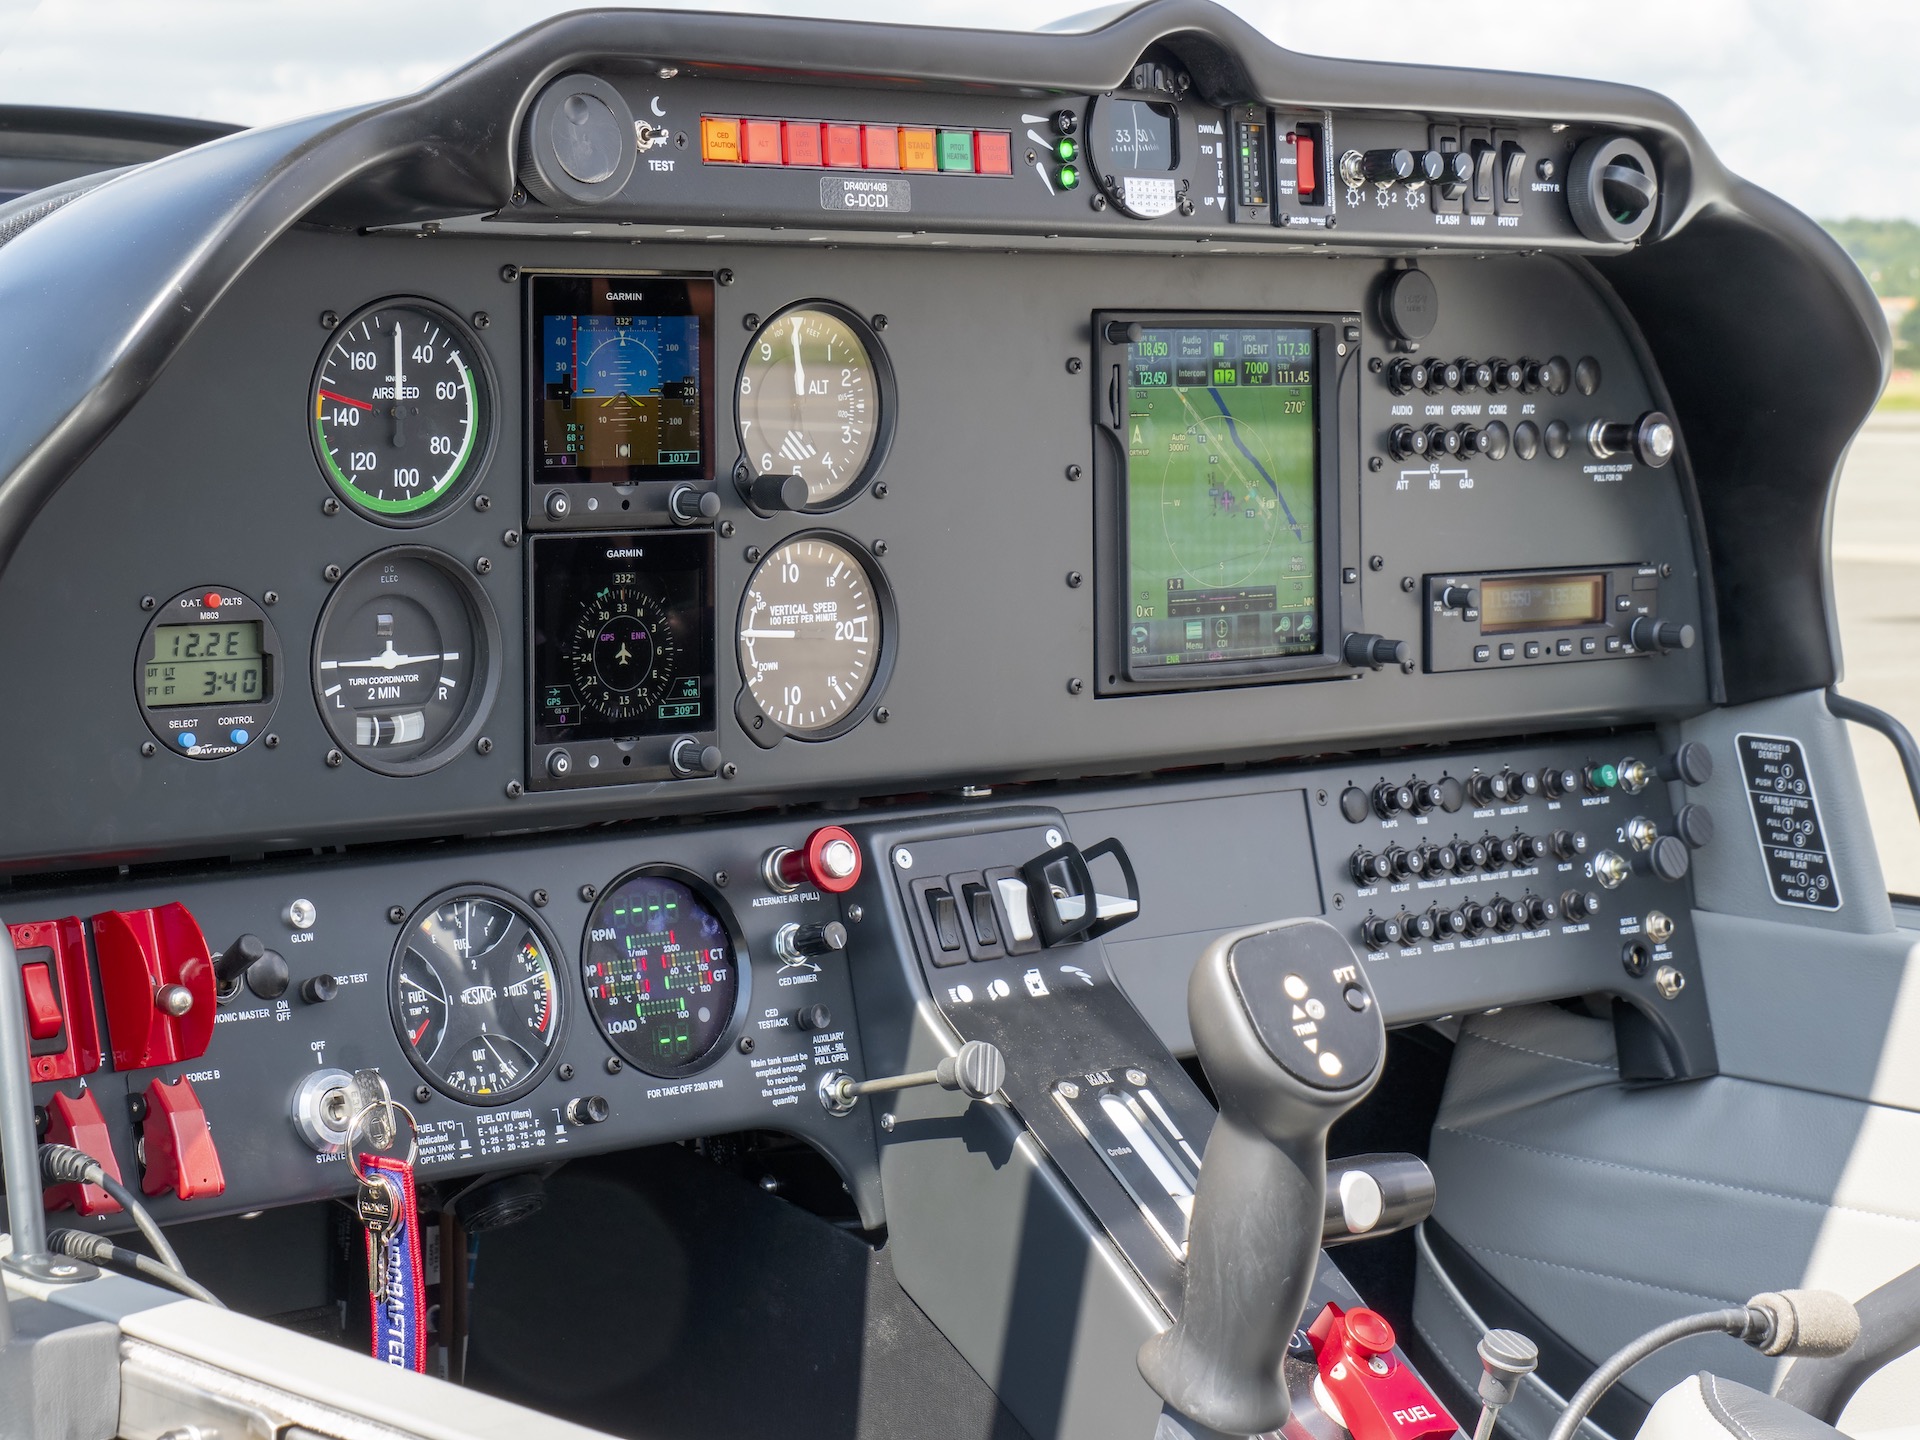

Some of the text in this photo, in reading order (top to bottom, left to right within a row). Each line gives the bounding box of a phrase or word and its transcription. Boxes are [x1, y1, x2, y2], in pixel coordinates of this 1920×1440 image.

[1199, 125, 1214, 134] DWN
[1116, 130, 1130, 143] 33
[648, 160, 675, 172] TEST
[844, 181, 888, 192] DR400/140B
[844, 193, 888, 208] G-DCDI
[1435, 215, 1459, 225] FLASH
[1471, 216, 1485, 226] NAV
[1498, 217, 1518, 226] PITOT
[606, 293, 642, 301] GARMIN
[555, 337, 567, 346] 40
[1182, 336, 1201, 344] Audio
[412, 345, 433, 363] 40
[1138, 343, 1167, 357] 118.450
[1183, 347, 1201, 355] Panel
[1244, 344, 1268, 355] IDENT
[1277, 343, 1310, 356] 117.30
[351, 352, 377, 370] 160
[555, 362, 567, 371] 30
[1179, 369, 1206, 378] Intercom
[1245, 362, 1268, 374] 7000
[1139, 372, 1167, 385] 123.450
[1278, 371, 1310, 383] 111.45
[436, 381, 456, 400] 60
[809, 380, 829, 394] ALT
[1392, 406, 1412, 415] AUDIO
[1425, 405, 1481, 415] COM1 GPS/NAV
[1489, 405, 1507, 414] COM2
[1522, 404, 1535, 414] ATC
[334, 408, 359, 426] 140
[430, 436, 450, 454] 80
[351, 452, 377, 470] 120
[669, 454, 690, 463] 1017
[1583, 465, 1597, 473] CABIN
[394, 468, 419, 487] 100
[1396, 480, 1409, 490] ATT
[607, 549, 643, 558] GARMIN
[381, 575, 399, 583] ELEC
[782, 564, 799, 583] 10
[617, 604, 628, 612] 33
[770, 602, 837, 616] VERTICAL SPEED
[770, 613, 837, 626] 100 FEET PER MINUTE
[601, 633, 615, 641] GPS
[631, 632, 646, 640] ENR
[835, 621, 854, 641] 20
[759, 662, 778, 671] DOWN
[203, 669, 257, 696] 3:40
[349, 674, 419, 686] TURN COORDINATOR
[368, 686, 400, 700] 2 MIN
[637, 688, 647, 697] 12
[784, 686, 801, 705] 10
[169, 719, 198, 728] SELECT
[218, 716, 254, 726] CONTROL
[1750, 741, 1790, 753] WINDSHIELD
[1758, 750, 1782, 760] DEMIST
[1759, 795, 1808, 809] CABIN HEATING
[1473, 809, 1495, 818] AVIONICS
[1773, 805, 1794, 815] FRONT
[1382, 820, 1398, 828] FLAPS
[1617, 828, 1625, 843] 2
[1774, 850, 1823, 863] CABIN HEATING
[1585, 862, 1593, 878] 3
[1790, 860, 1807, 869] REAR
[1358, 888, 1378, 897] DISPLAY
[753, 892, 820, 907] ALTERNATE AIR (PULL)
[291, 933, 313, 943] GLOW
[592, 928, 616, 942] RPM
[454, 939, 471, 950] FUEL
[663, 944, 680, 953] 2300
[1432, 943, 1455, 952] STARTER
[517, 954, 524, 963] 16
[710, 948, 723, 960] CT
[1368, 953, 1384, 962] FADEC
[713, 969, 726, 981] GT
[779, 974, 817, 986] CED DIMMER
[1332, 965, 1356, 983] PTT
[408, 991, 427, 1004] FUEL
[277, 1000, 288, 1009] ON
[276, 1012, 291, 1021] OFF
[765, 1009, 779, 1018] CED
[608, 1020, 637, 1034] LOAD
[758, 1018, 789, 1030] TEST/ACK
[1293, 1021, 1317, 1036] TRIM
[812, 1031, 845, 1044] AUXILIARY
[311, 1041, 325, 1050] OFF
[473, 1049, 485, 1061] OAT
[751, 1053, 808, 1068] Main tank must be
[815, 1053, 849, 1065] PULL OPEN
[214, 1070, 220, 1079] B
[756, 1063, 806, 1079] emptied enough
[80, 1078, 87, 1088] A
[767, 1075, 798, 1086] to receive
[647, 1079, 723, 1099] FOR TAKE OFF 2300 RPM
[762, 1083, 806, 1097] the transfered
[773, 1095, 798, 1107] quantity
[477, 1109, 532, 1125] FUEL QTY (liters)
[418, 1134, 449, 1145] indicated
[419, 1143, 455, 1156] MAIN TANK
[1107, 1146, 1132, 1157] Cruise
[421, 1153, 455, 1165] OPT. TANK
[1393, 1405, 1437, 1425] FUEL
